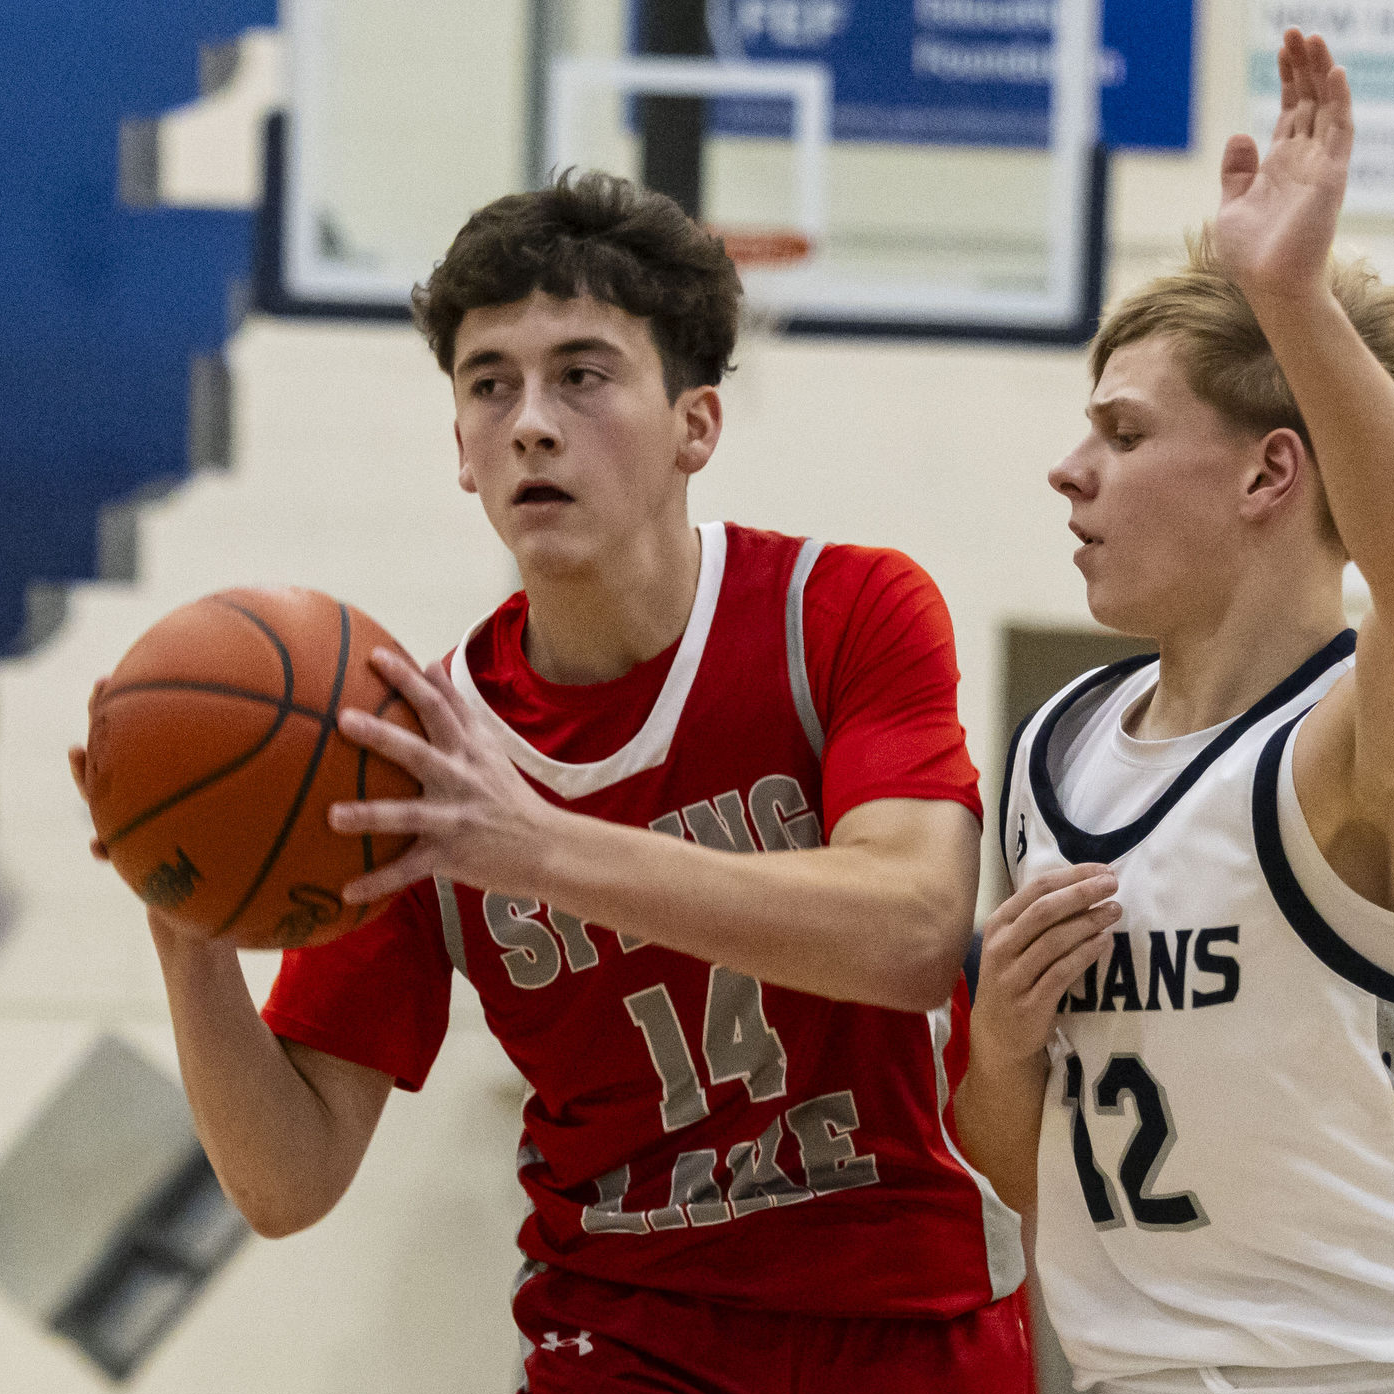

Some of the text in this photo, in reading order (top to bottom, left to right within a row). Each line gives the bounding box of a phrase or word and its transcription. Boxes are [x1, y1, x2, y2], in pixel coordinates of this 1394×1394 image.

[623, 964, 787, 1133] 14
[580, 1089, 881, 1236] LAKE
[1061, 1051, 1211, 1233] 12
